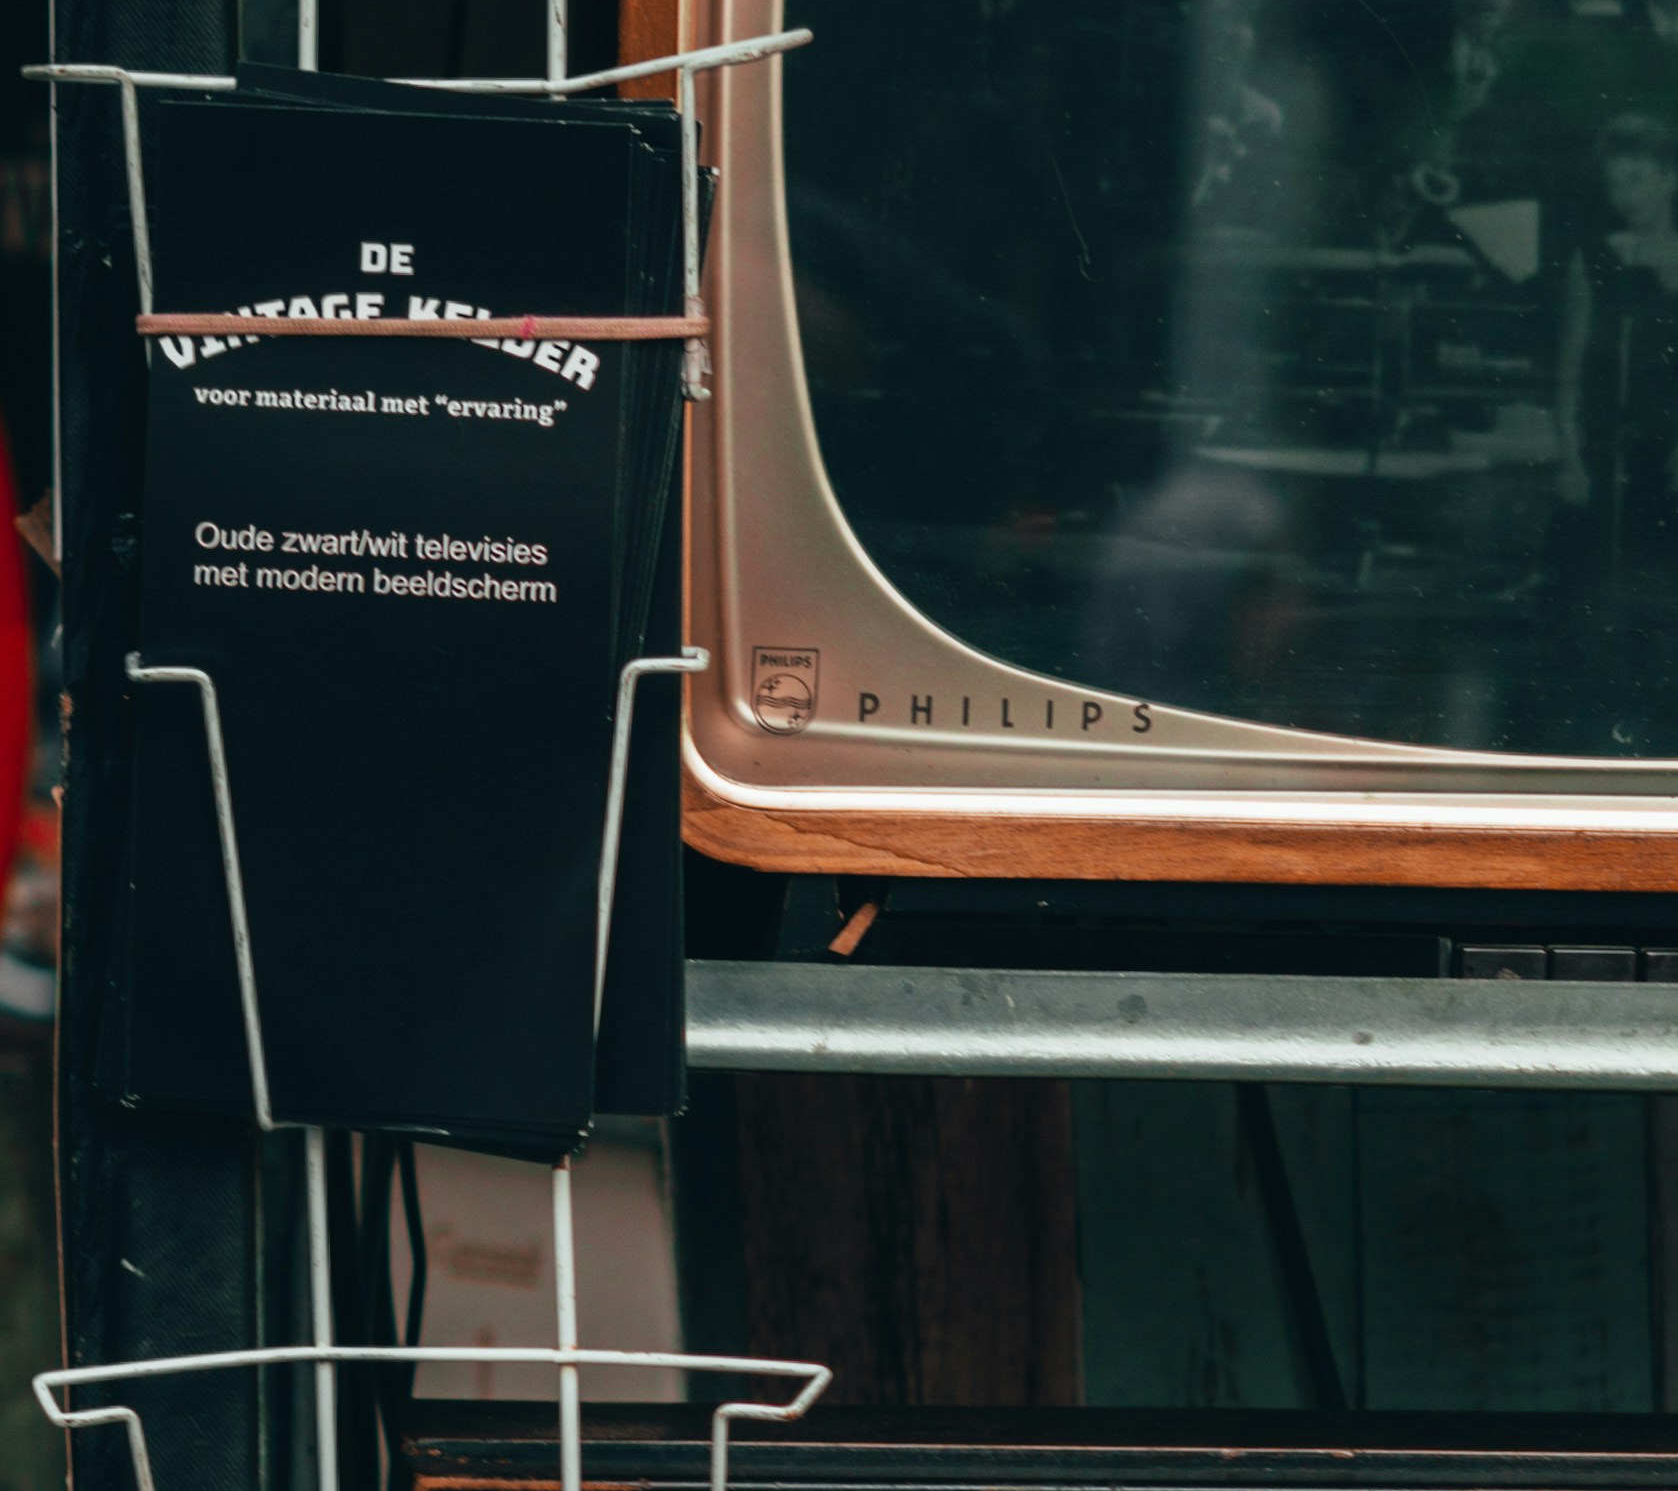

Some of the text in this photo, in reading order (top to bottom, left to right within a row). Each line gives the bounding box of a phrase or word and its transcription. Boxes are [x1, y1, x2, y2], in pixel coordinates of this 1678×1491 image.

[360, 242, 414, 275] DE
[194, 388, 252, 406] voor
[254, 388, 377, 413] materiaal
[380, 395, 430, 416] met
[195, 521, 548, 565] Oude zwart/wit televisies
[194, 562, 557, 603] met modern beeldscherm
[857, 691, 1153, 734] PHILIPS
